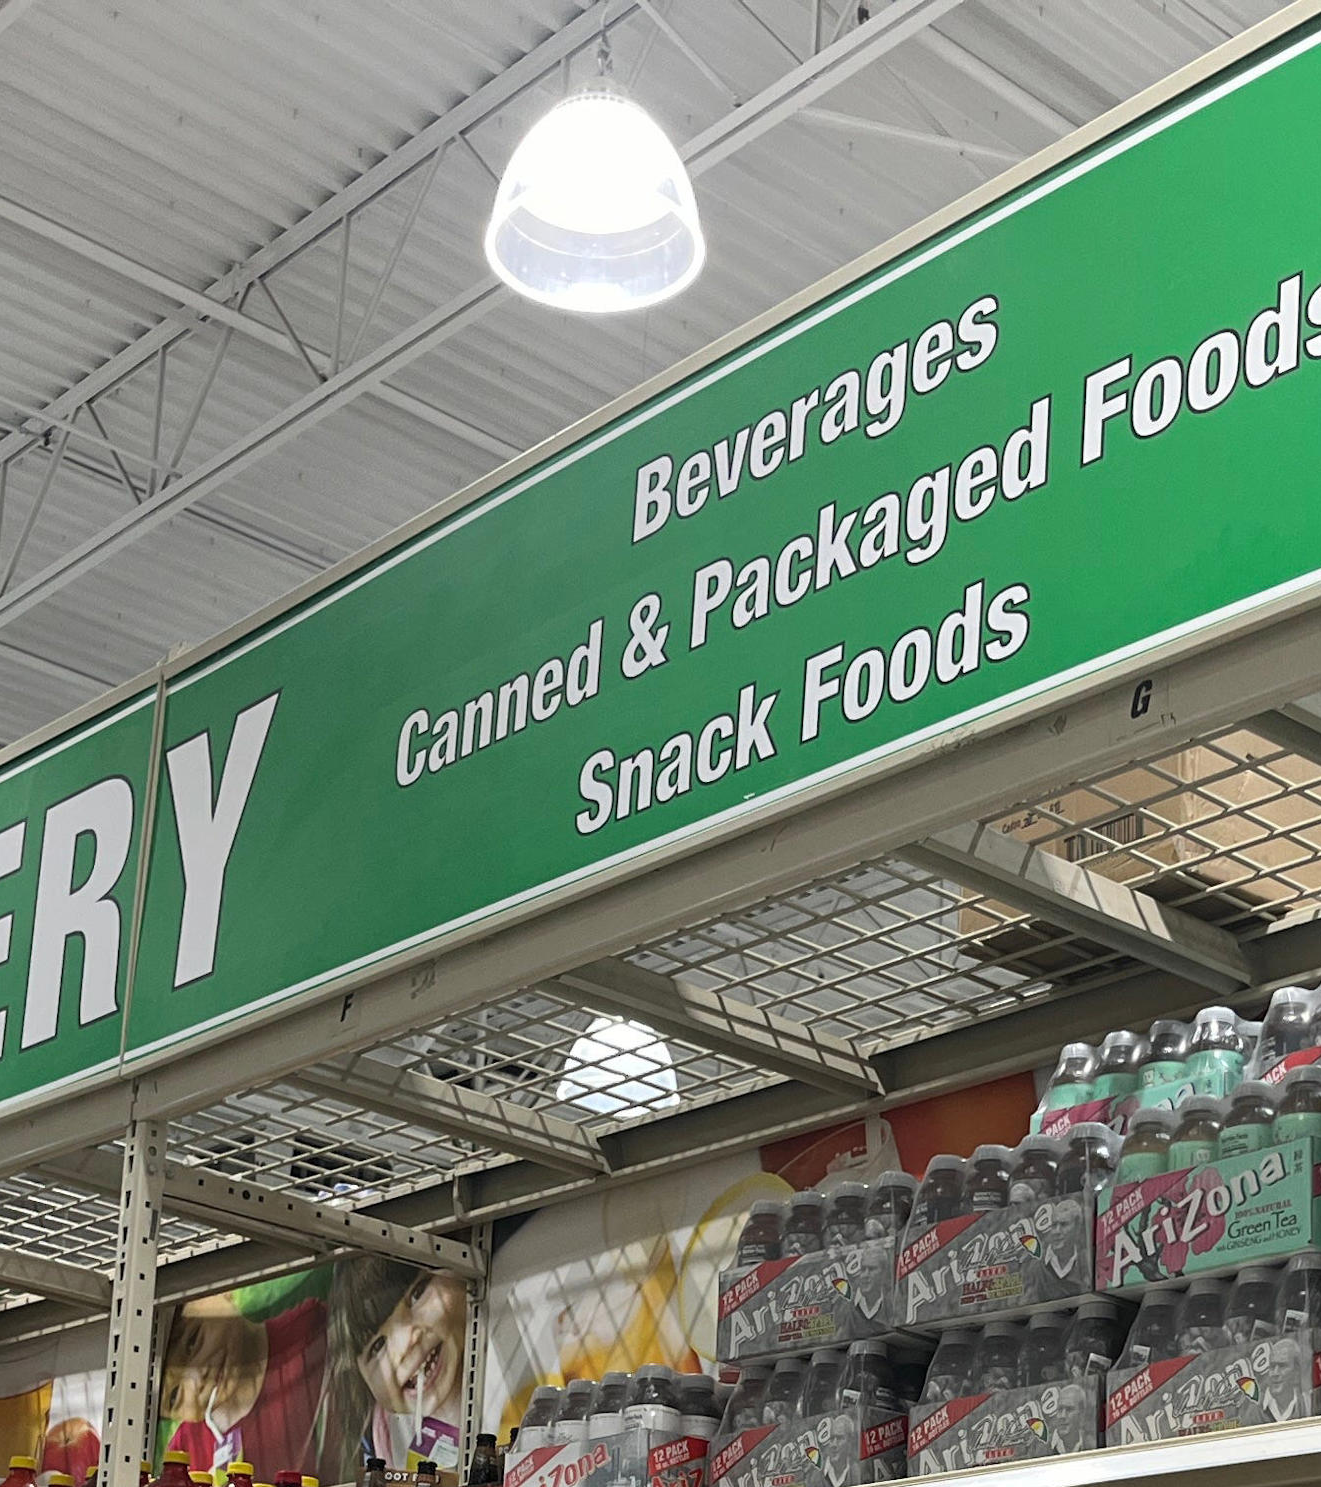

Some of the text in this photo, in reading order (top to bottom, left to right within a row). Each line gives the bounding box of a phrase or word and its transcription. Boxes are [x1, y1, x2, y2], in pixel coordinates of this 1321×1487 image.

[631, 293, 1000, 544] Beverages
[393, 618, 603, 789] Canned
[620, 591, 670, 680] &
[689, 398, 1052, 651] Packaged
[575, 581, 1031, 838] Snack Foods
[1100, 1186, 1146, 1230] 12 PACK
[1108, 1151, 1289, 1289] AriZona
[1226, 1210, 1299, 1242] Green Tea
[653, 1439, 690, 1462] 12 PACK
